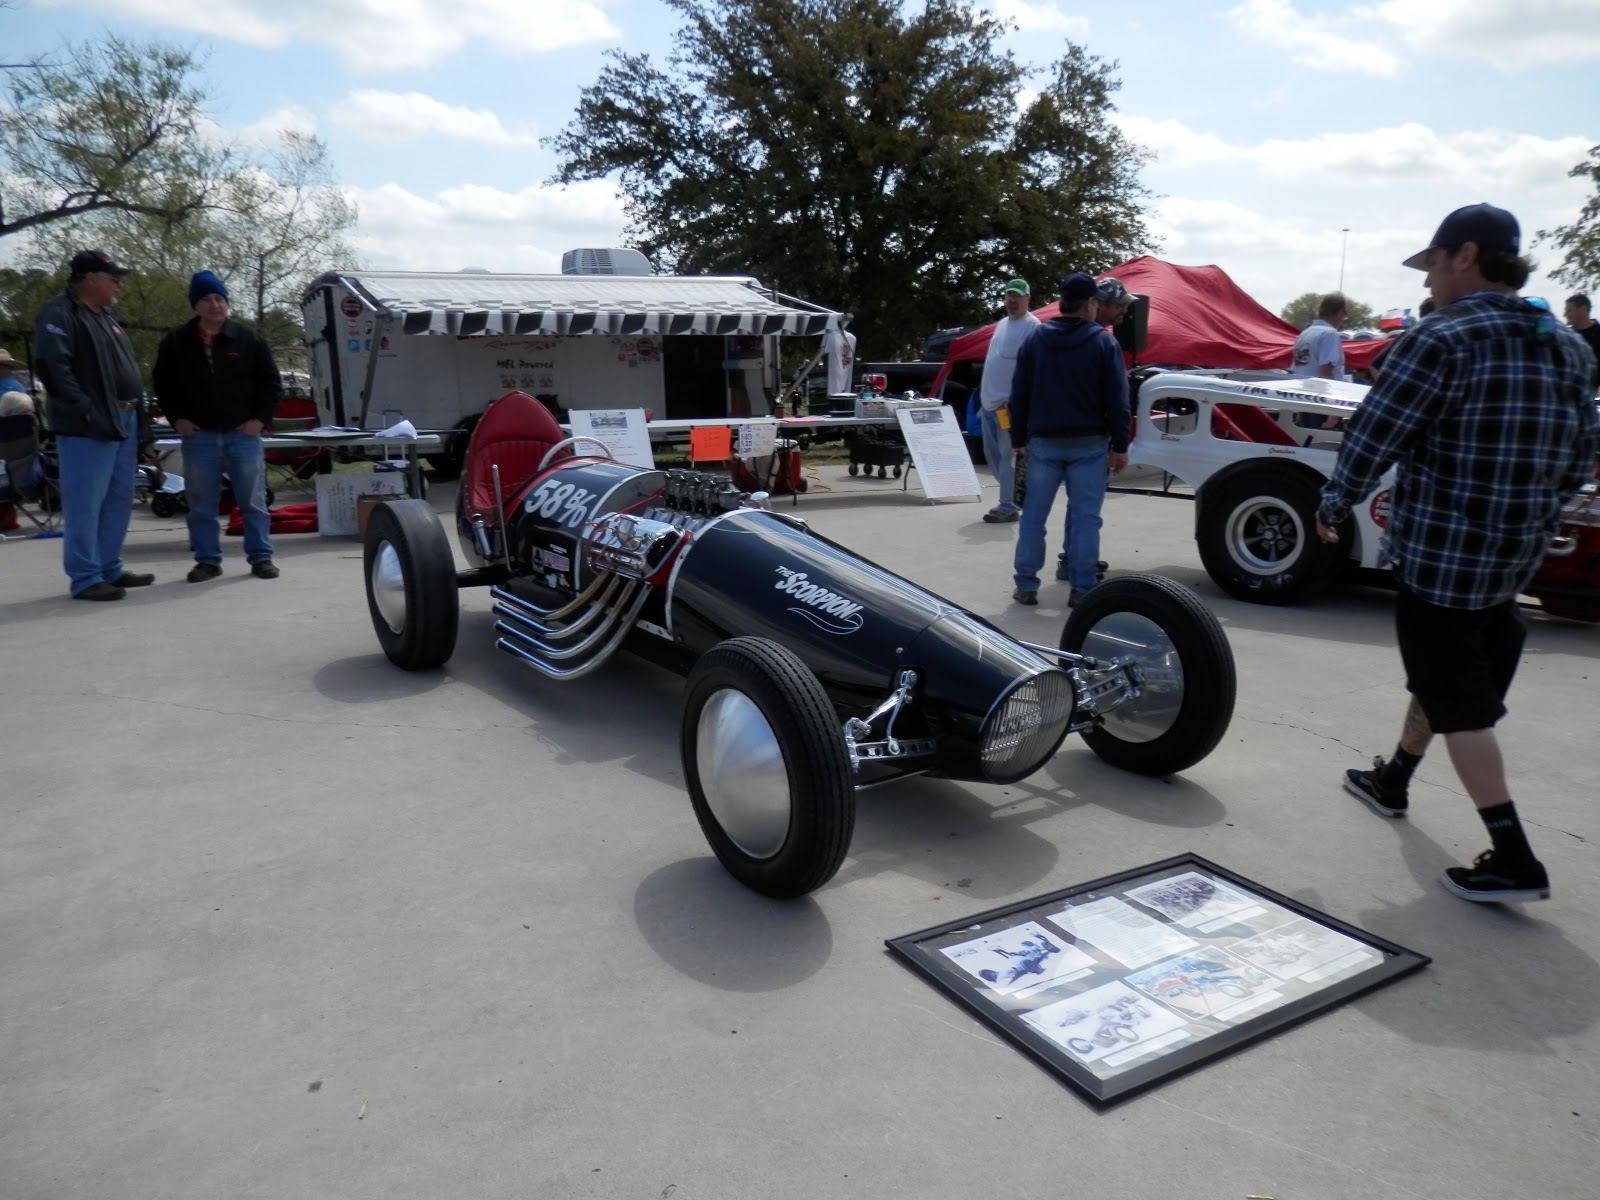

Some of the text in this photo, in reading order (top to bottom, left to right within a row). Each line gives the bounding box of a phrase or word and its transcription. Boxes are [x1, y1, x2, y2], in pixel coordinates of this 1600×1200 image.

[519, 359, 554, 369] Powered
[774, 565, 796, 577] THE
[774, 572, 864, 619] SCORPION
